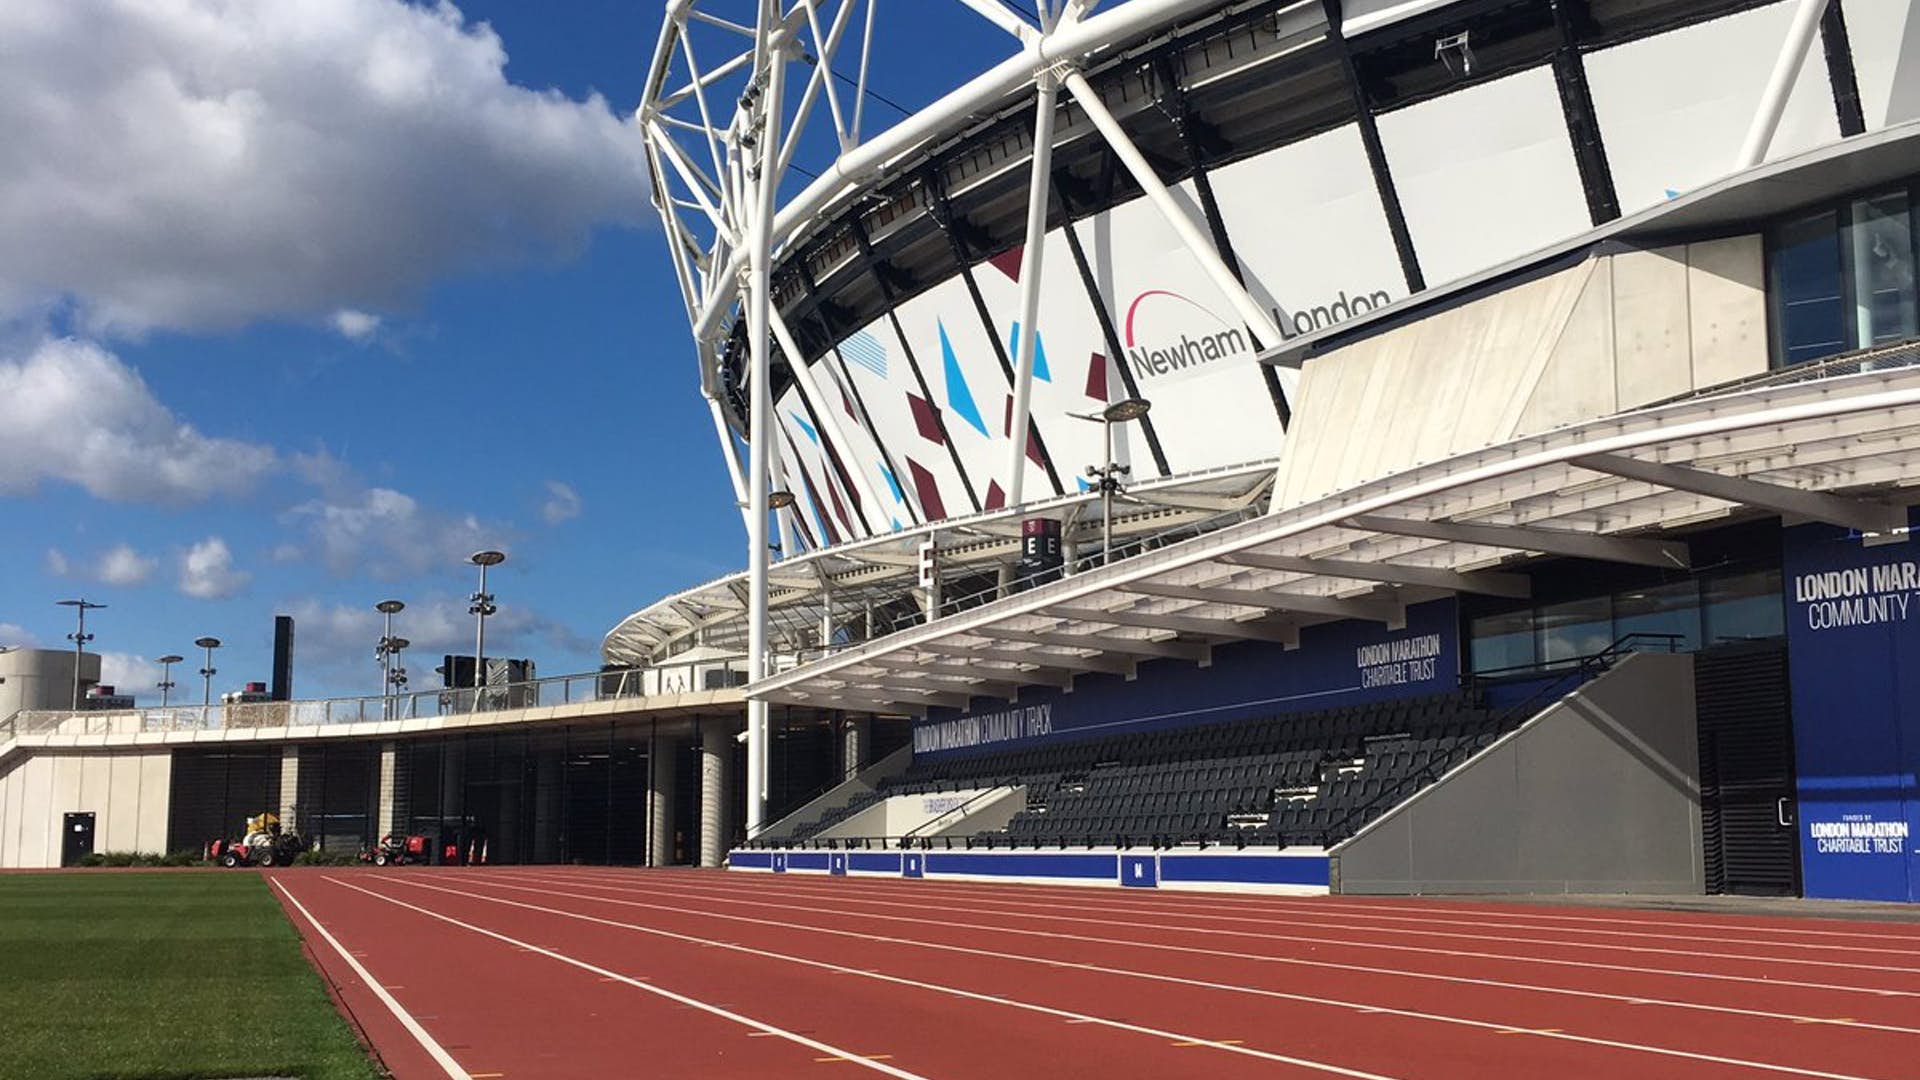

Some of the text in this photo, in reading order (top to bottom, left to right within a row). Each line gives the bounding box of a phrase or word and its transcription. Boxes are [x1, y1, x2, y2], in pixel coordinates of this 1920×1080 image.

[1130, 289, 1391, 380] Newham London
[1028, 537, 1036, 554] E
[1048, 537, 1056, 554] E
[919, 541, 936, 587] E
[1796, 562, 1920, 603] LONDON MAR
[1808, 592, 1910, 630] COMMUNITY
[1357, 634, 1440, 668] LONDON MARATHON
[1361, 658, 1436, 688] CHARITABLE TRUST
[914, 703, 1052, 753] LONDON MARATHON COMMUNITY TRACK
[1810, 821, 1909, 838] LONDON MARATHON
[1817, 838, 1904, 853] CHARITABLE TRUST
